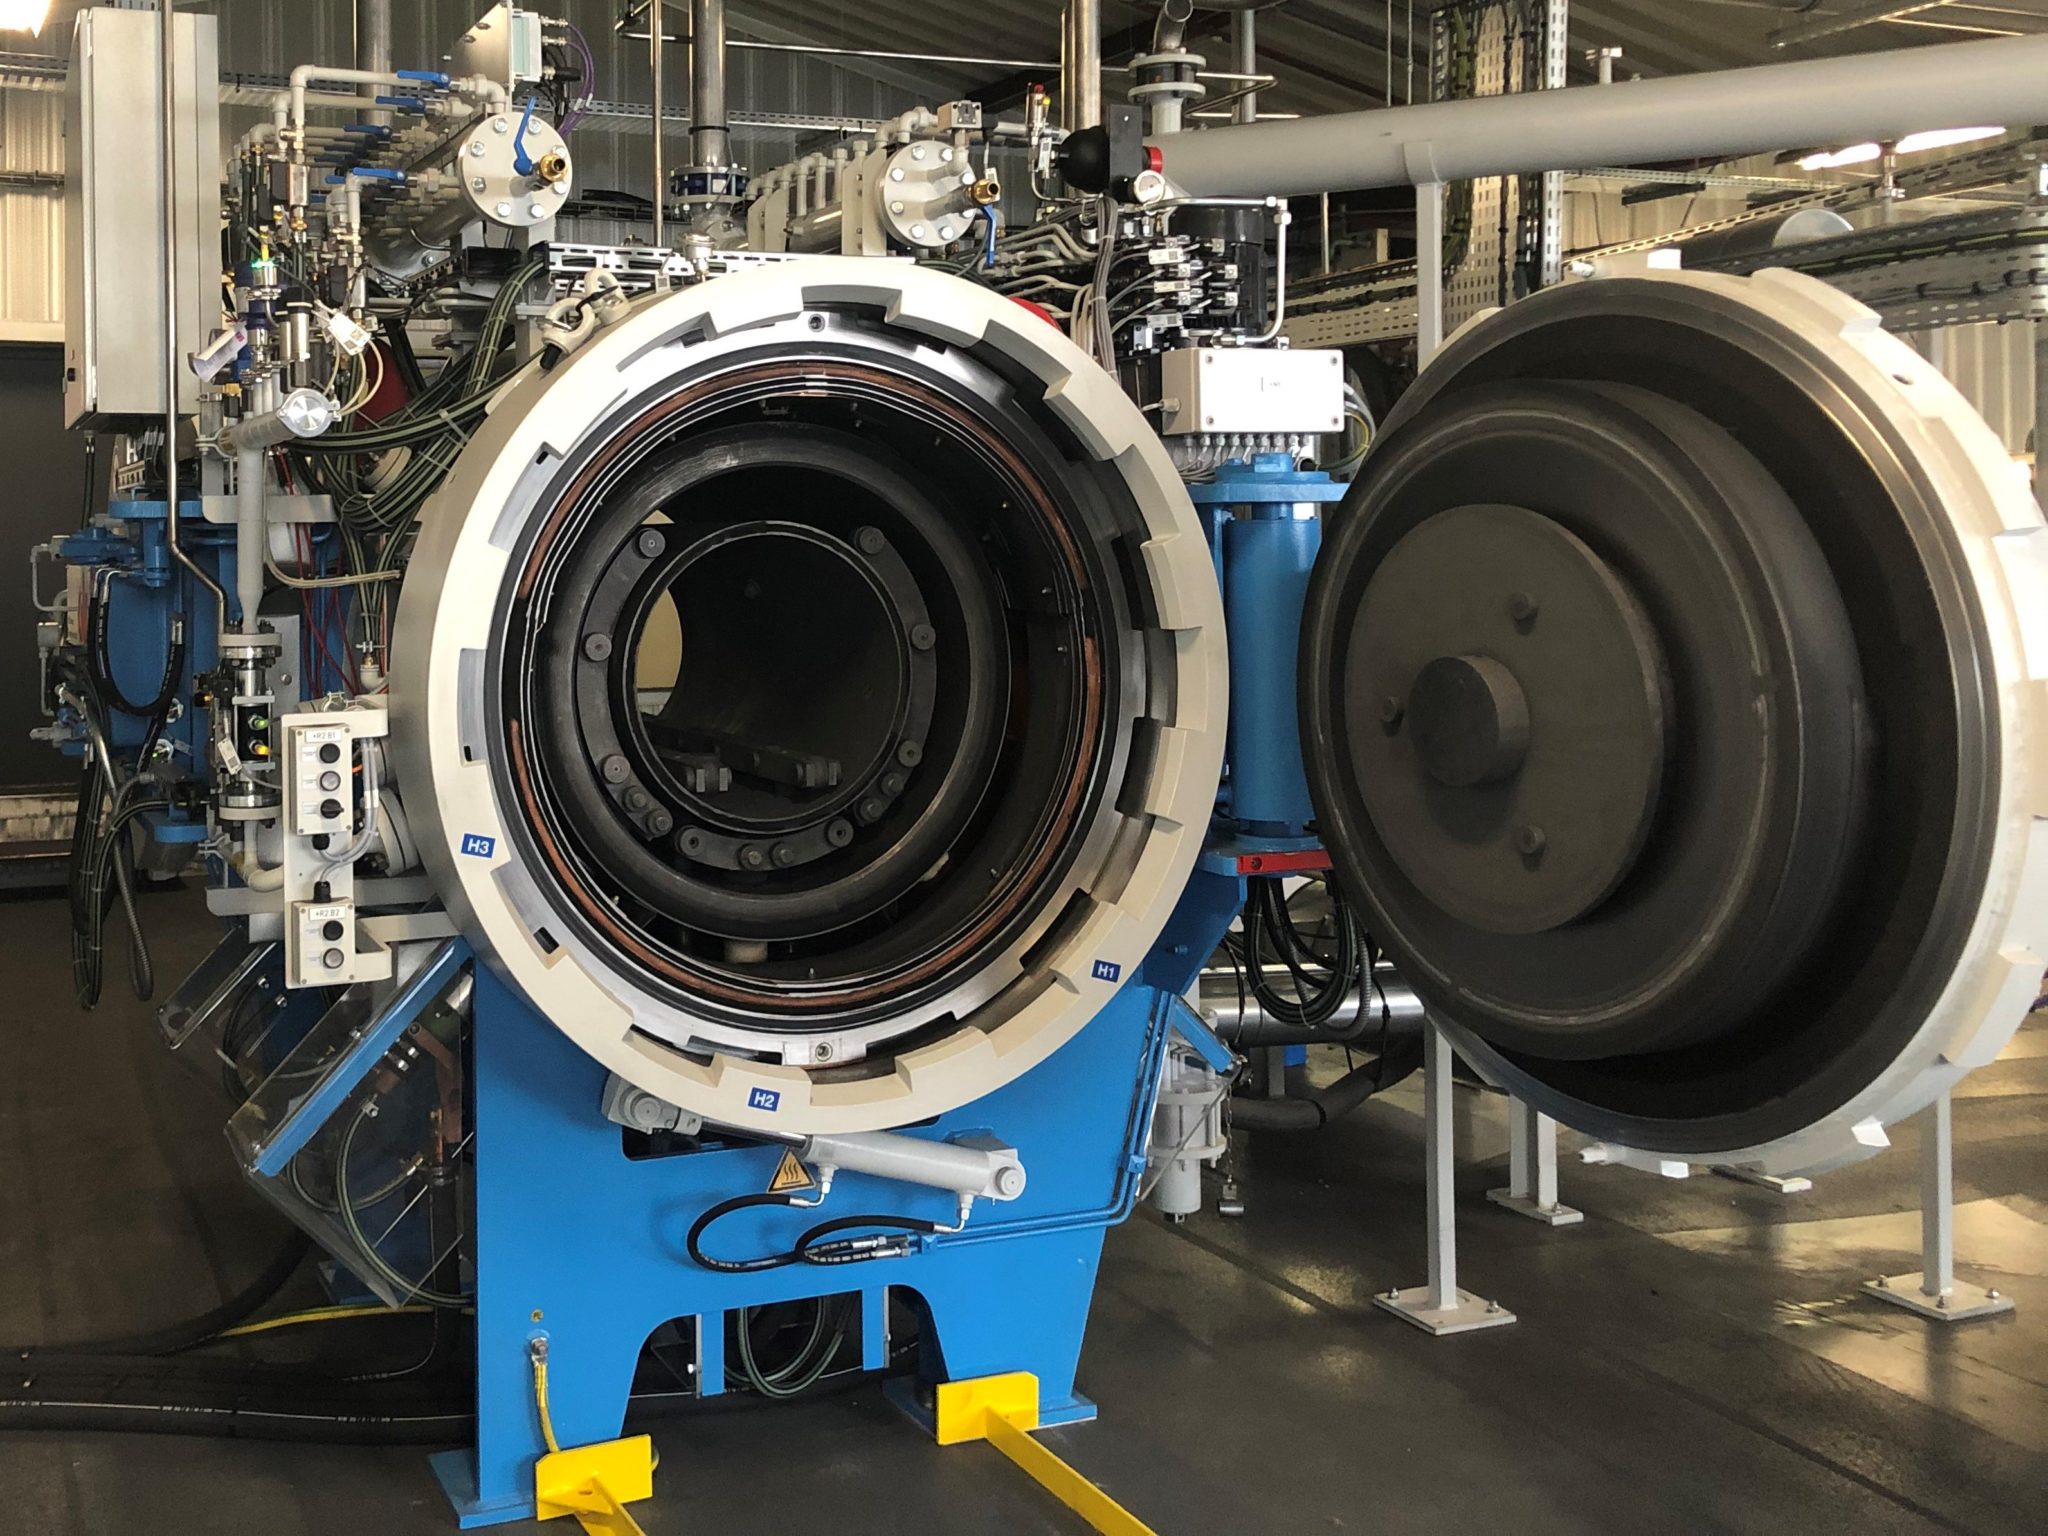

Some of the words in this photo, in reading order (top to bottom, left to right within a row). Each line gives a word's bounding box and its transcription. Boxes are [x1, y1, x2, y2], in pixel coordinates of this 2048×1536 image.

[467, 838, 490, 854] H3
[1097, 963, 1115, 979] H1
[754, 1091, 775, 1108] H2
